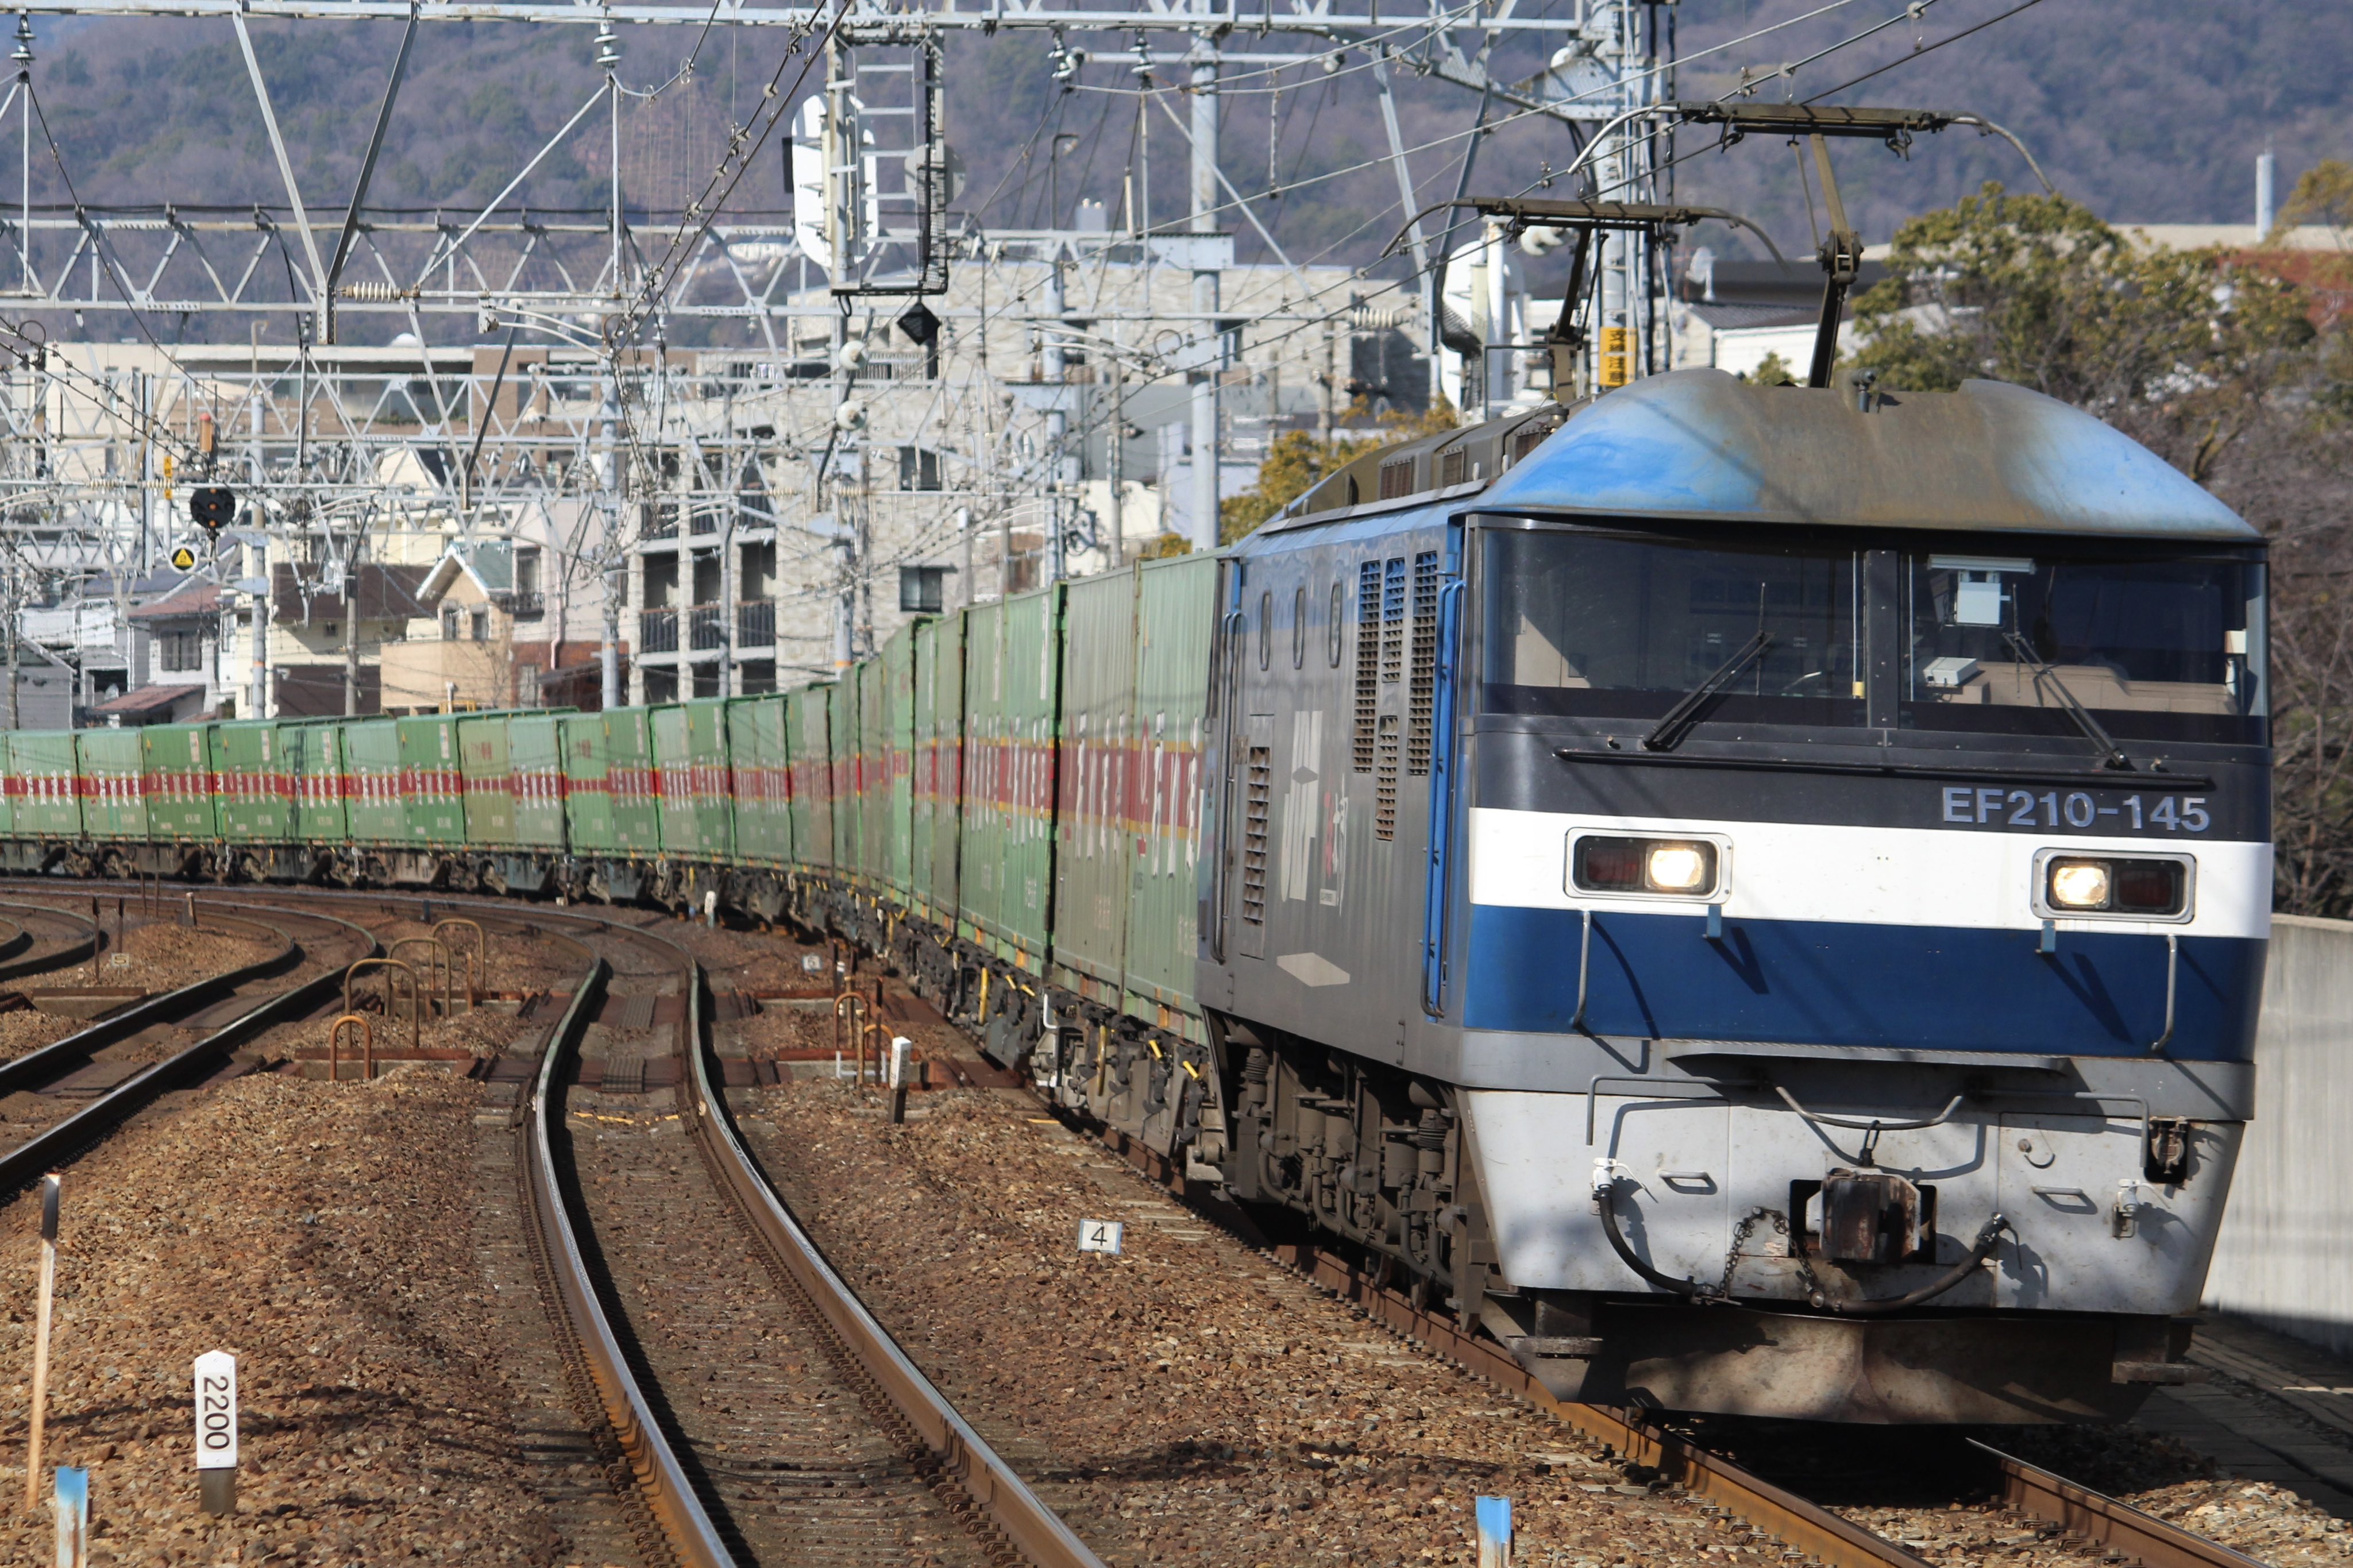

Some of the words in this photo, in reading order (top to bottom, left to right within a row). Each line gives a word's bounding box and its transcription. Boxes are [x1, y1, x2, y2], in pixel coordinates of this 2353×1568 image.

[1942, 786, 2211, 832] EF210-145
[114, 955, 126, 965] 5
[1090, 1226, 1108, 1246] 4
[203, 1376, 230, 1450] 2200
